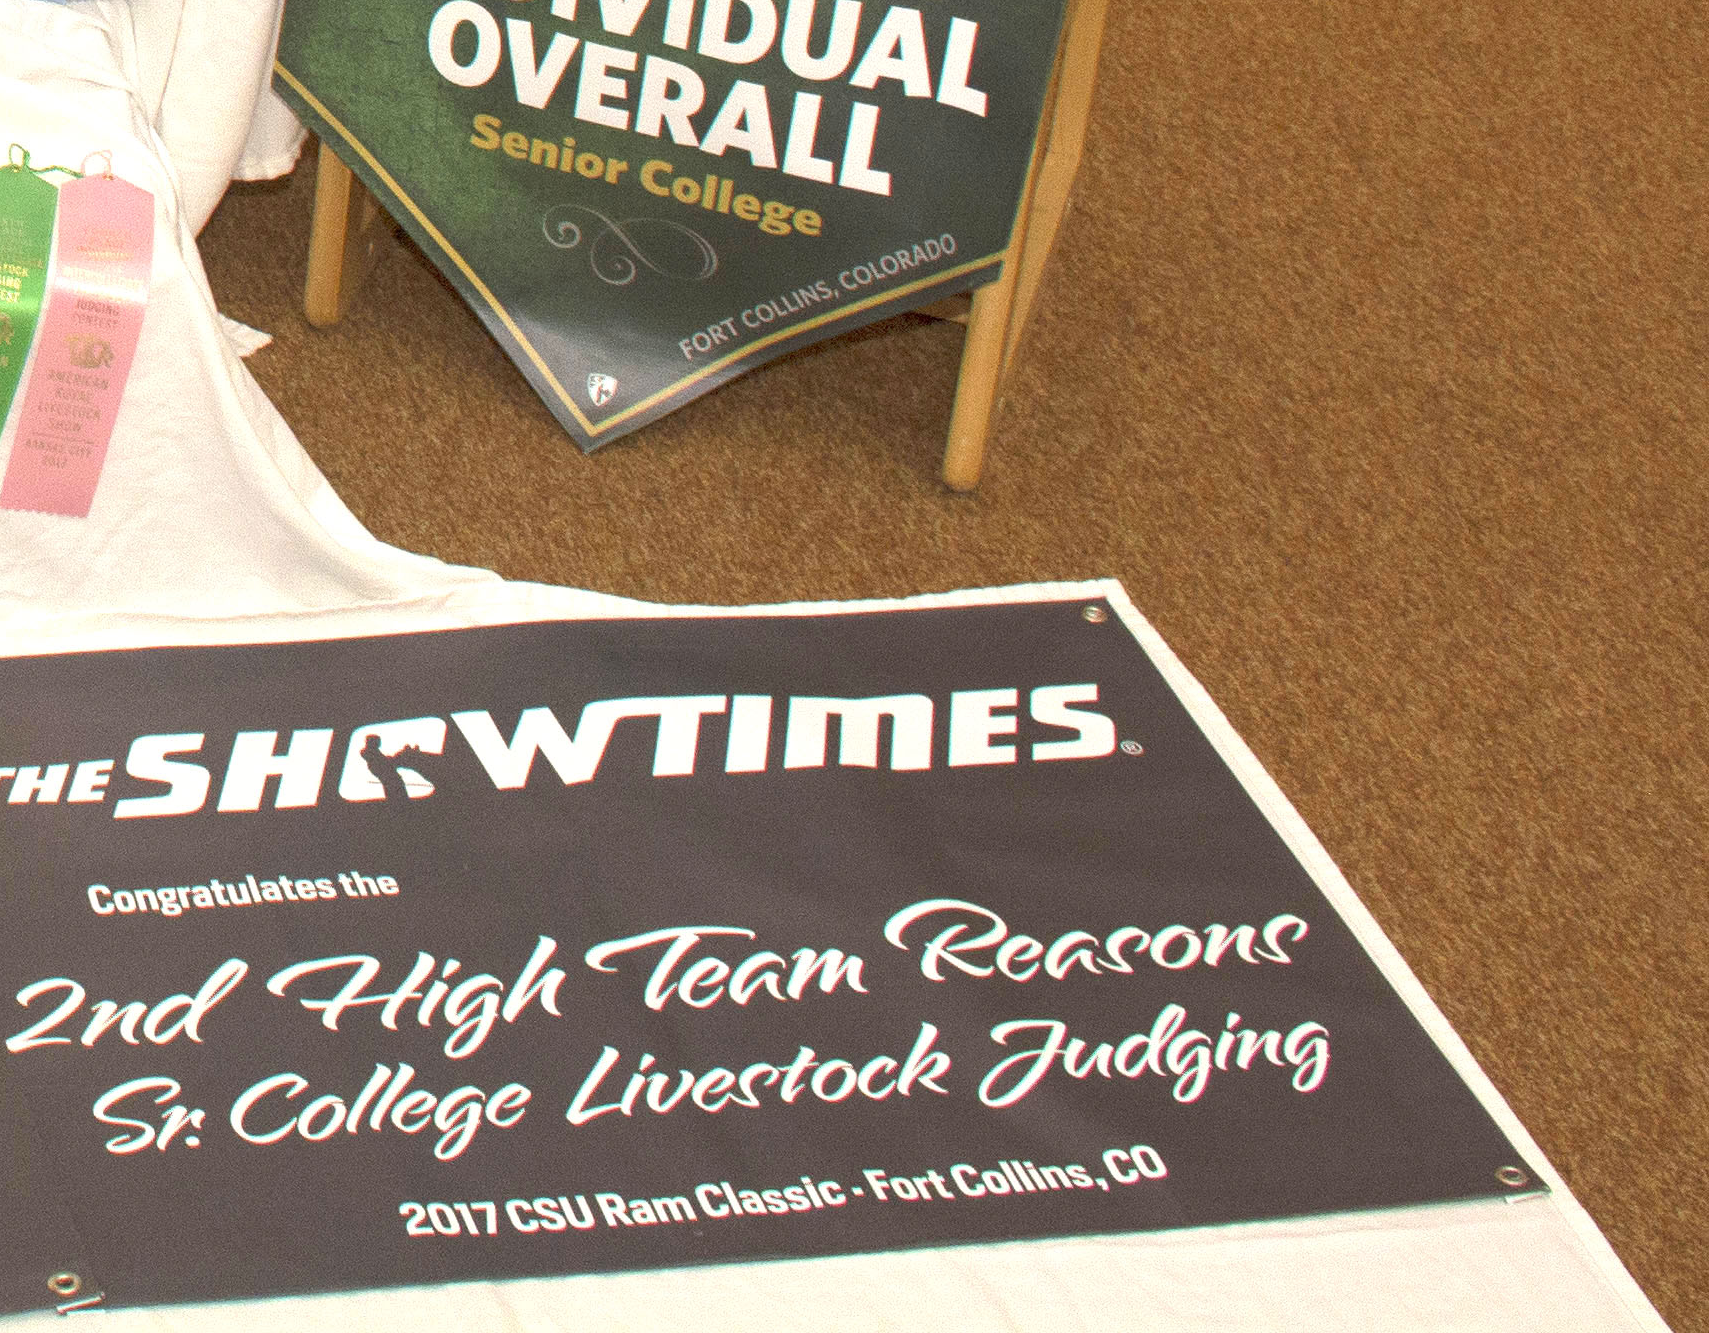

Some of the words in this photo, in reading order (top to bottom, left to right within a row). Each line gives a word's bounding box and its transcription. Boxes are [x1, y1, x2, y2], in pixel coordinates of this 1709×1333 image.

[426, 0, 891, 196] OVERALL
[470, 114, 628, 186] Senior
[642, 160, 824, 238] College
[676, 315, 741, 363] FORT
[738, 279, 840, 335] COLLINS,
[836, 233, 958, 292] COLORADO
[110, 683, 1119, 818] SHOWTIMES
[86, 874, 332, 917] Congratulates
[337, 868, 398, 903] the
[5, 960, 250, 1054] 2nd
[267, 934, 567, 1060] High
[586, 925, 870, 1013] Team
[883, 898, 1308, 983] Reasons
[91, 1074, 206, 1158] Sr.
[228, 1061, 531, 1160] College
[564, 1023, 951, 1129] Livestock
[978, 1003, 1331, 1109] Judging
[400, 1199, 500, 1237] 2017
[505, 1192, 593, 1234] CSU
[595, 1186, 693, 1227] Ram
[694, 1175, 849, 1220] Classic
[865, 1163, 949, 1203] Fort
[950, 1154, 1112, 1197] Collins,
[1113, 1143, 1168, 1184] CO
